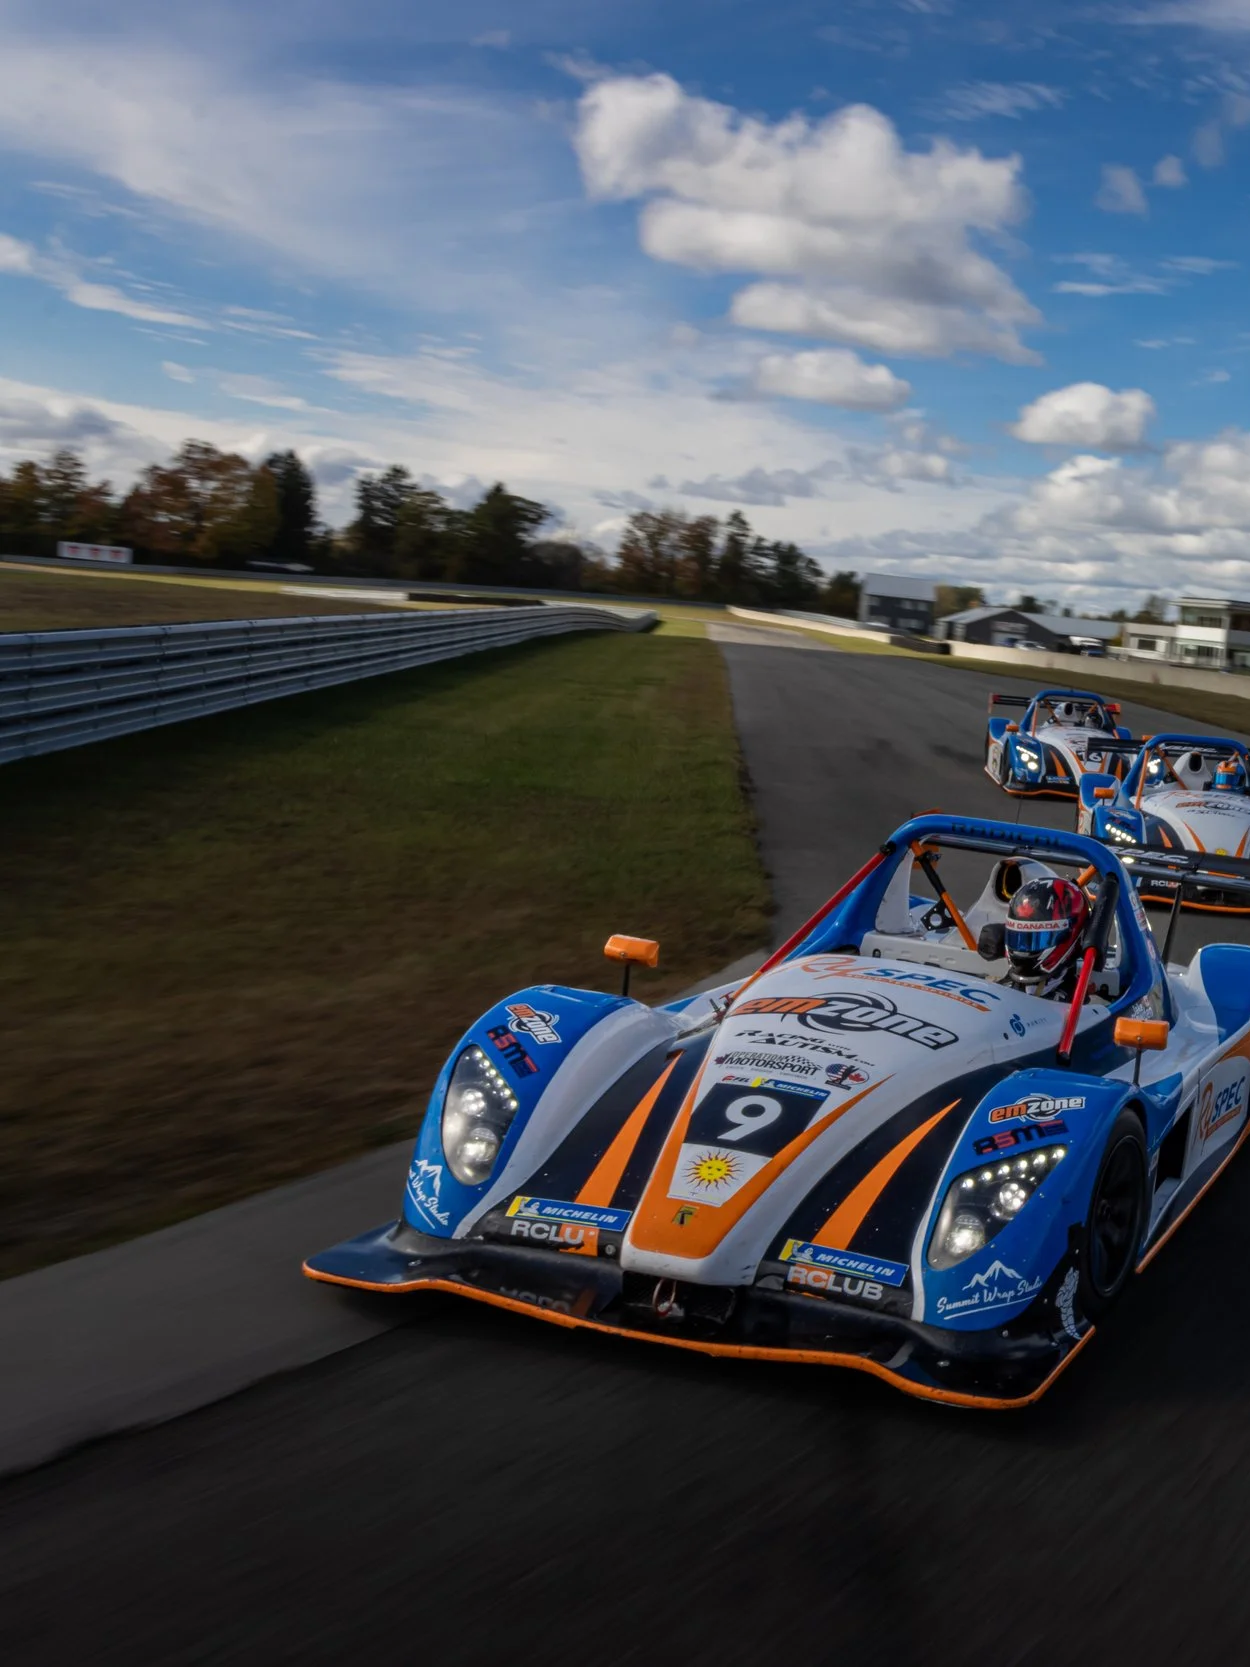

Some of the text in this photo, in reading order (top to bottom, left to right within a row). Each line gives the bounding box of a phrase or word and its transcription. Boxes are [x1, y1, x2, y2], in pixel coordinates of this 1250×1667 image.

[1151, 880, 1182, 888] RCLU
[1016, 922, 1060, 930] CANADA
[506, 1003, 560, 1044] emzone
[727, 995, 960, 1050] emzone
[726, 1056, 820, 1076] MOTORSPORT
[728, 1051, 785, 1061] OPERATION
[776, 1082, 829, 1097] MICHELIN
[717, 1095, 783, 1141] 9
[990, 1097, 1085, 1123] emzone
[542, 1205, 619, 1224] MICHELIN
[815, 1253, 897, 1278] MICHELIN
[787, 1265, 884, 1300] RCLUB
[936, 1275, 1043, 1314] Summit Wrap Studi
